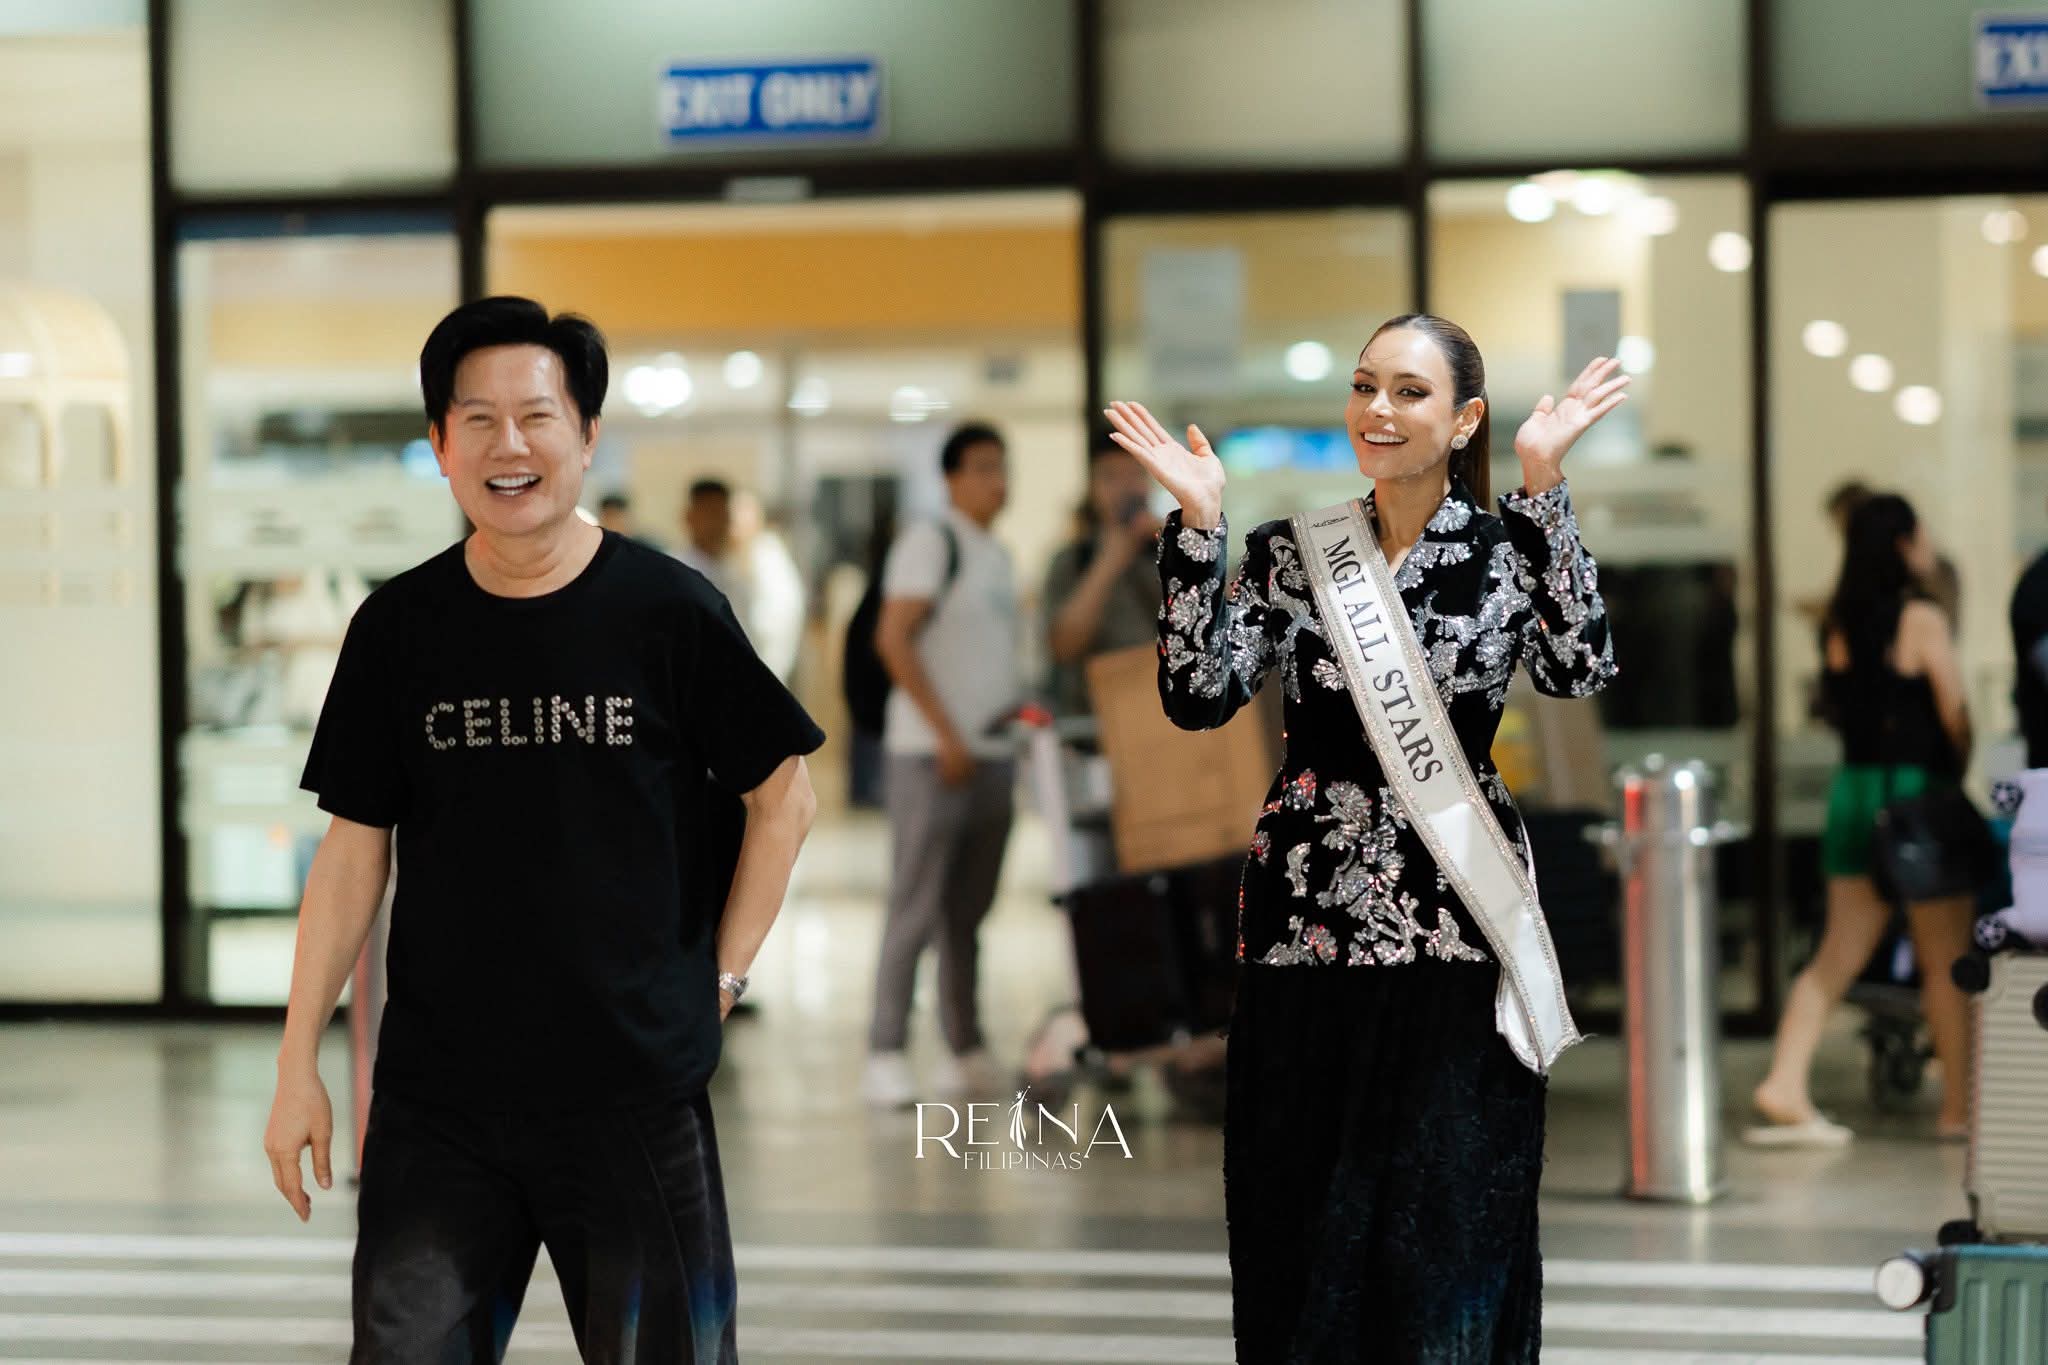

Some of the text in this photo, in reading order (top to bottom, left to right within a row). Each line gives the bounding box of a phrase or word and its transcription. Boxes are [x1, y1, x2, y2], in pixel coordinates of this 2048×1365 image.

[661, 69, 877, 129] EXIT ONLY
[1322, 535, 1366, 594] MGI
[1344, 600, 1390, 663] ALL
[1372, 669, 1444, 783] STARS
[425, 695, 633, 750] CELINE
